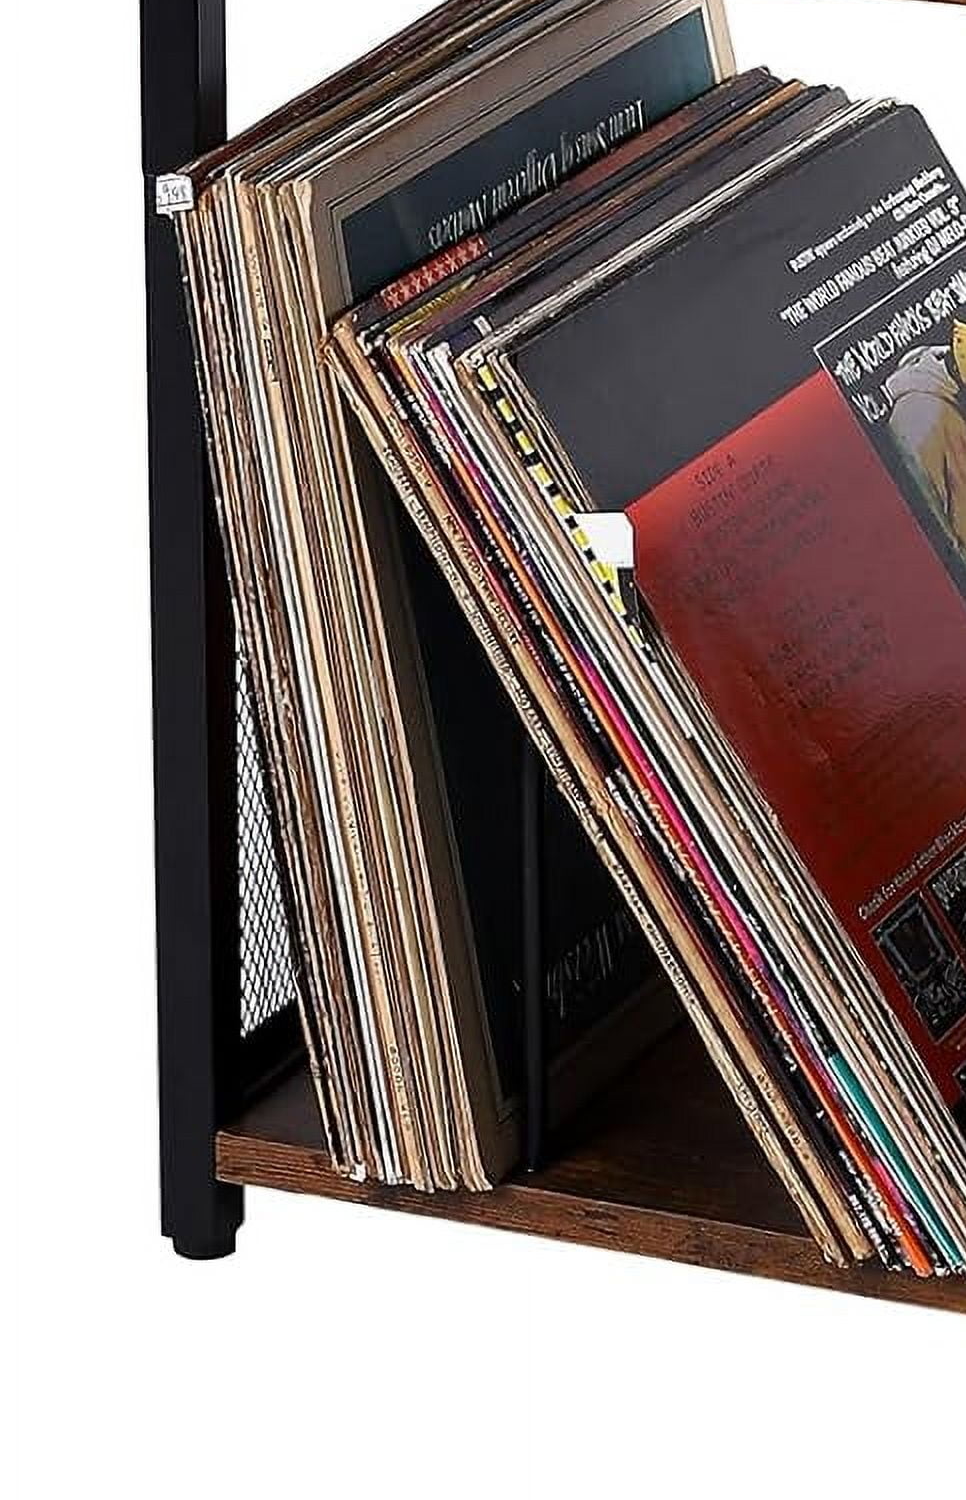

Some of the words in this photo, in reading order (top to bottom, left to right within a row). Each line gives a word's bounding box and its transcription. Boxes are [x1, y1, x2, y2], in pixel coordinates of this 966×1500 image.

[802, 280, 841, 314] WORLD
[834, 256, 877, 291] FAMOUS
[871, 242, 897, 267] BEAT
